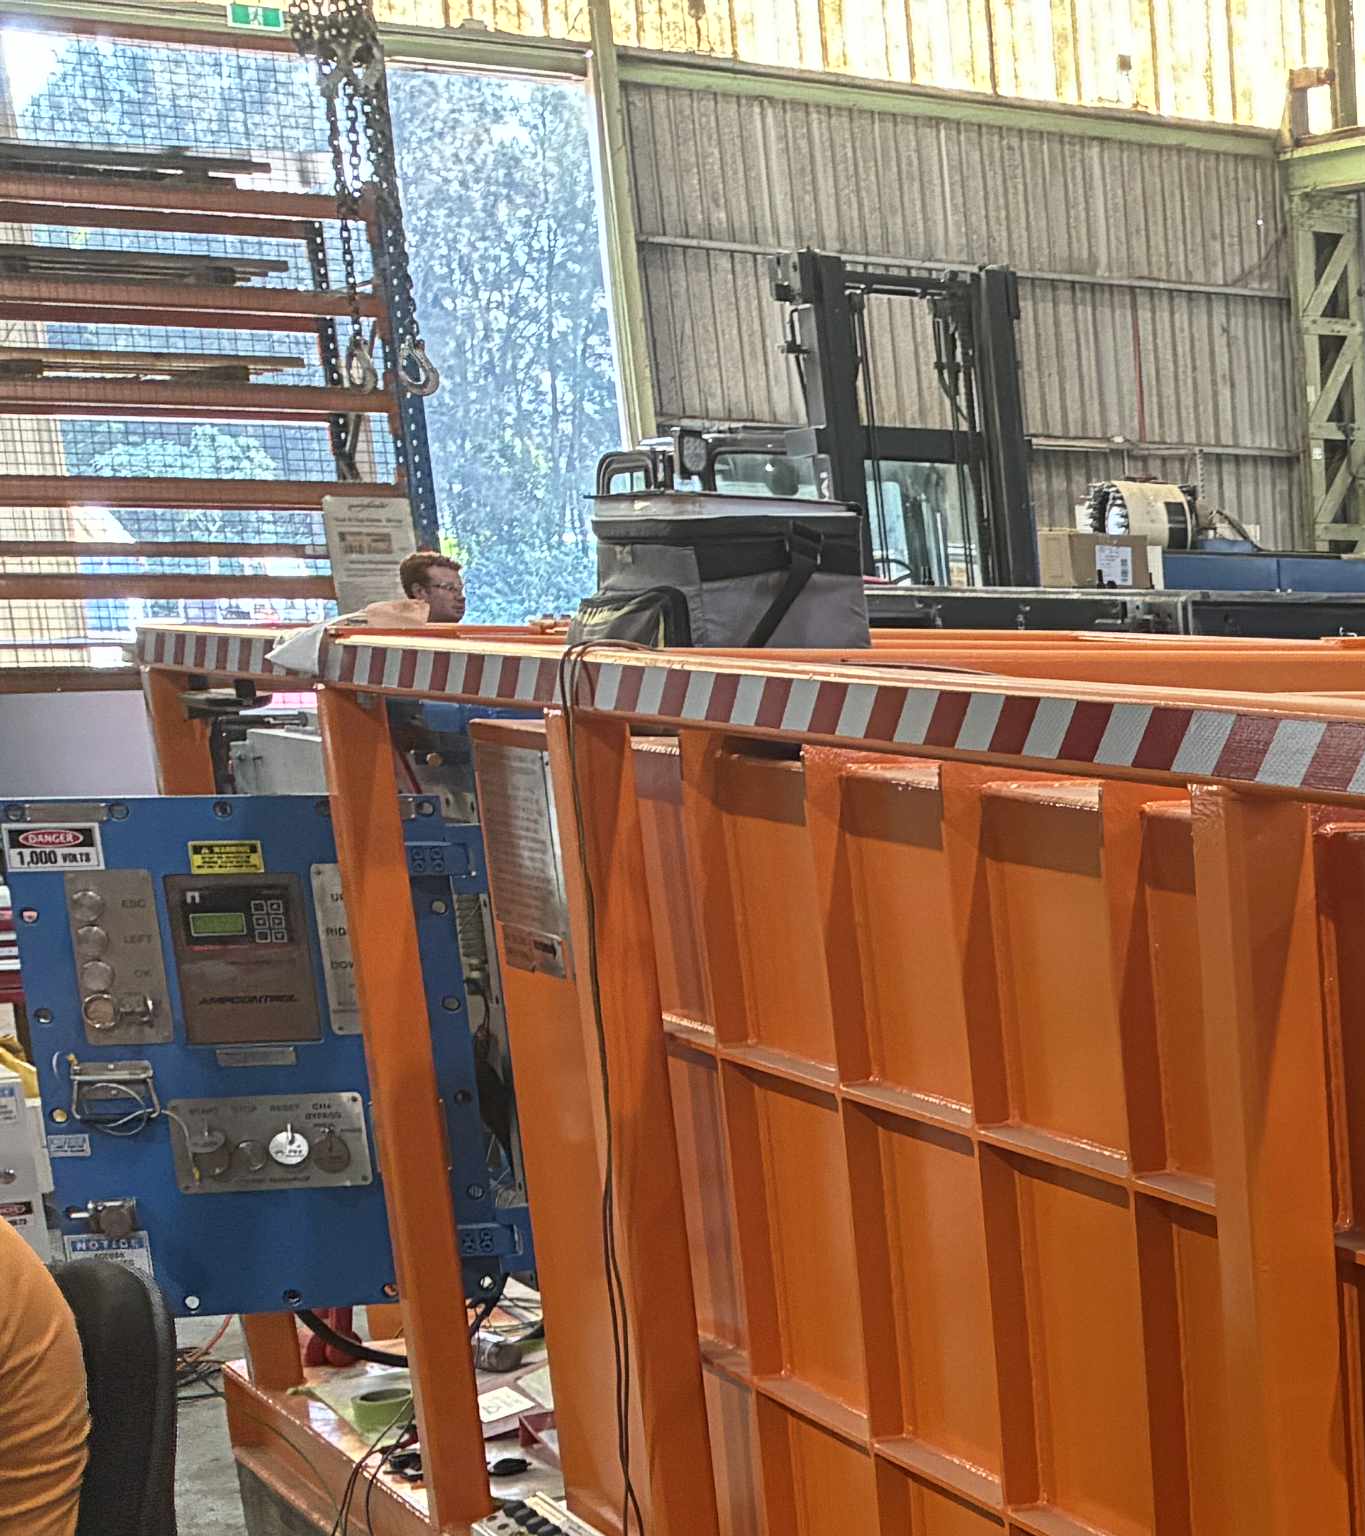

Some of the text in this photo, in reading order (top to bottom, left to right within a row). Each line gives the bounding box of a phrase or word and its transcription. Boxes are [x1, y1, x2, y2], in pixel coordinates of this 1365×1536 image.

[28, 833, 75, 844] DANGER
[17, 850, 91, 867] 1,000 VOLTS
[121, 899, 146, 909] ESC
